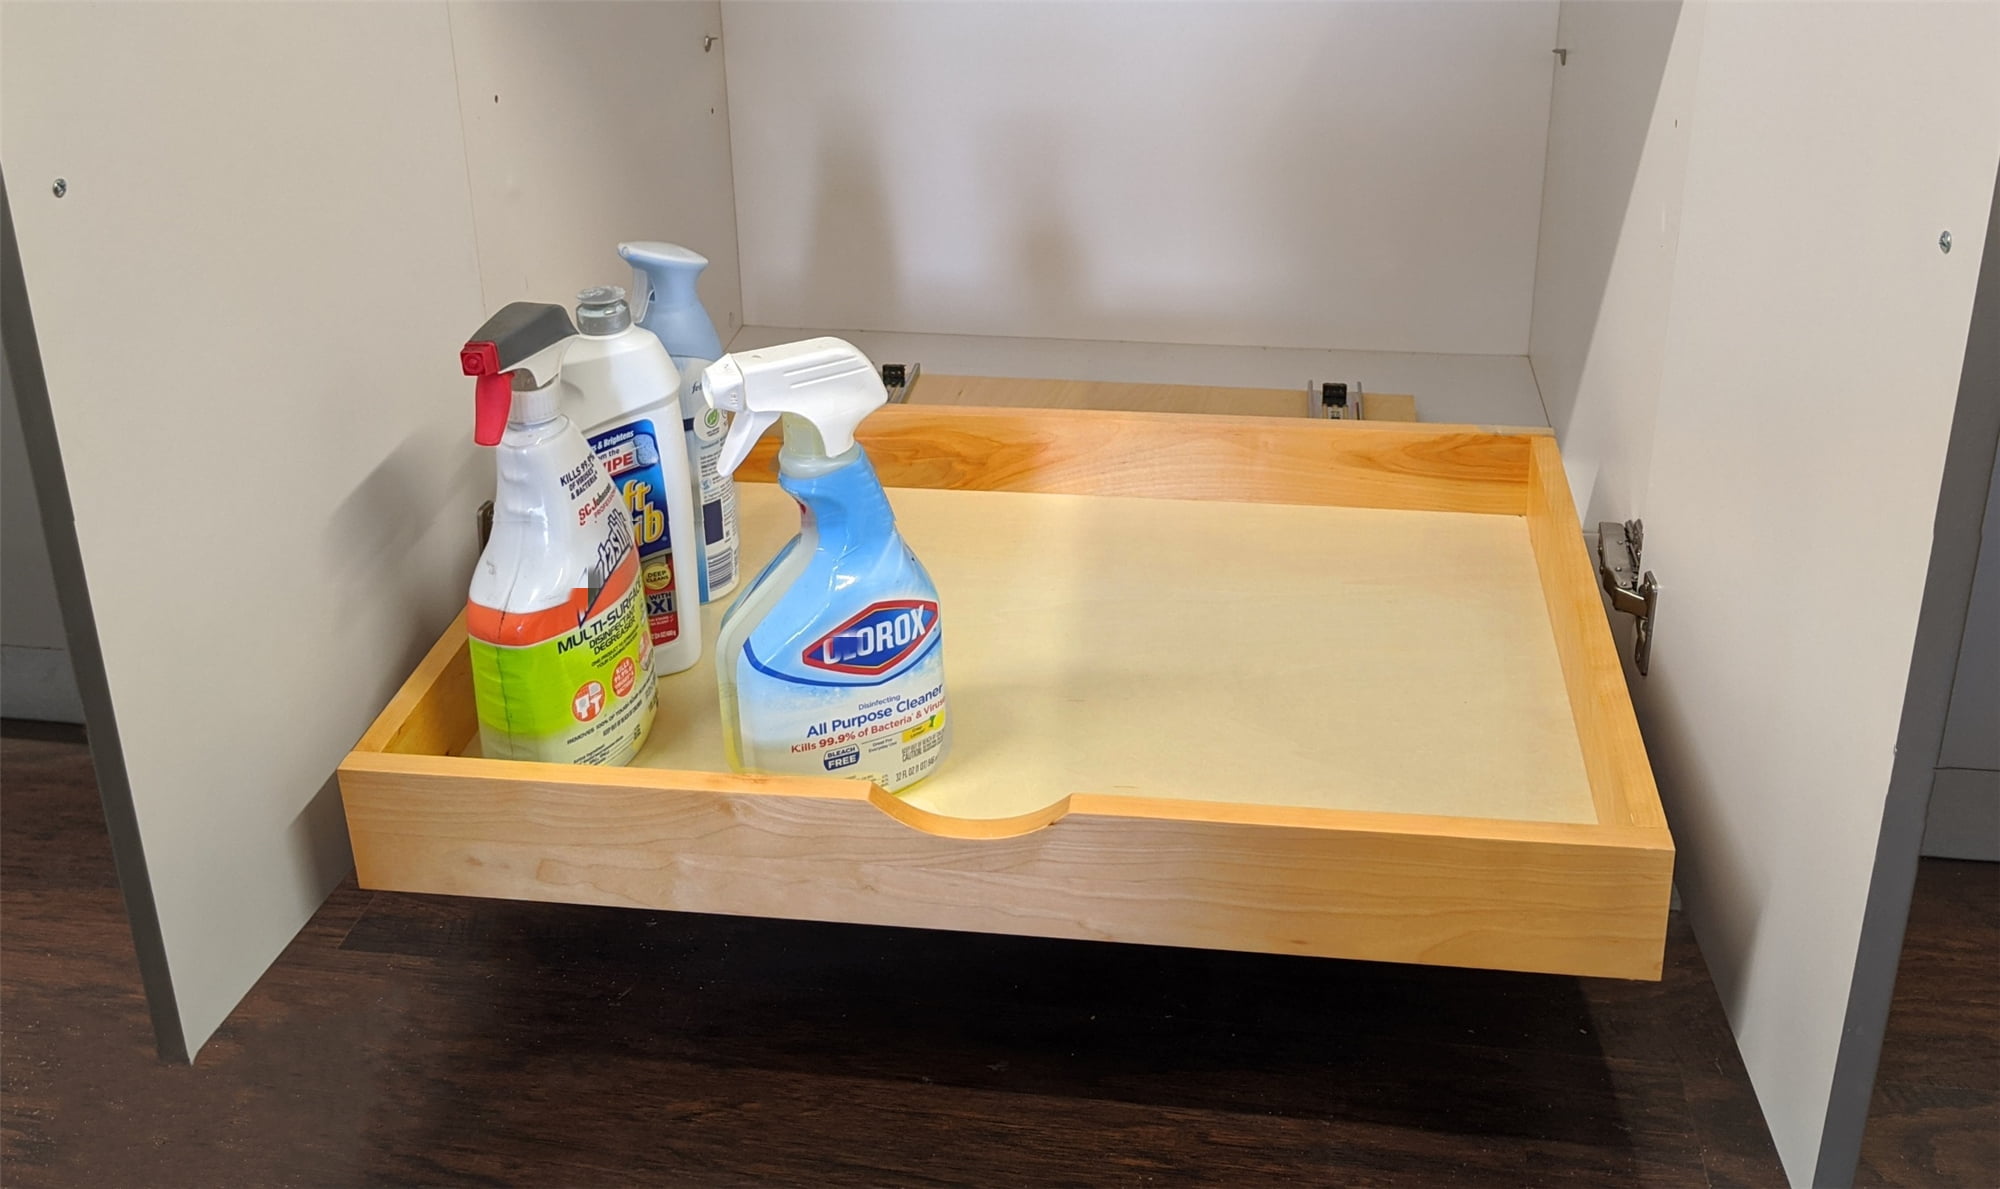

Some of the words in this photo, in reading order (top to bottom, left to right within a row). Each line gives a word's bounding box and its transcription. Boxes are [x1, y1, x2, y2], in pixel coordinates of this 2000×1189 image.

[603, 430, 634, 448] Brightens
[608, 448, 621, 458] the
[560, 466, 582, 487] KILLS
[569, 481, 577, 492] OF
[623, 480, 653, 513] ft
[646, 575, 669, 583] CLEANS
[647, 570, 667, 579] DEEP
[649, 592, 672, 601] WITH
[858, 694, 901, 711] Disinfecting
[806, 722, 828, 738] All
[832, 707, 893, 732] Purpose
[896, 684, 943, 713] Cleaner
[791, 740, 817, 753] Kills
[818, 731, 856, 748] 99.9%
[858, 728, 869, 738] of
[916, 711, 922, 720] &
[827, 747, 856, 758] BLEACH
[828, 754, 857, 769] FREE
